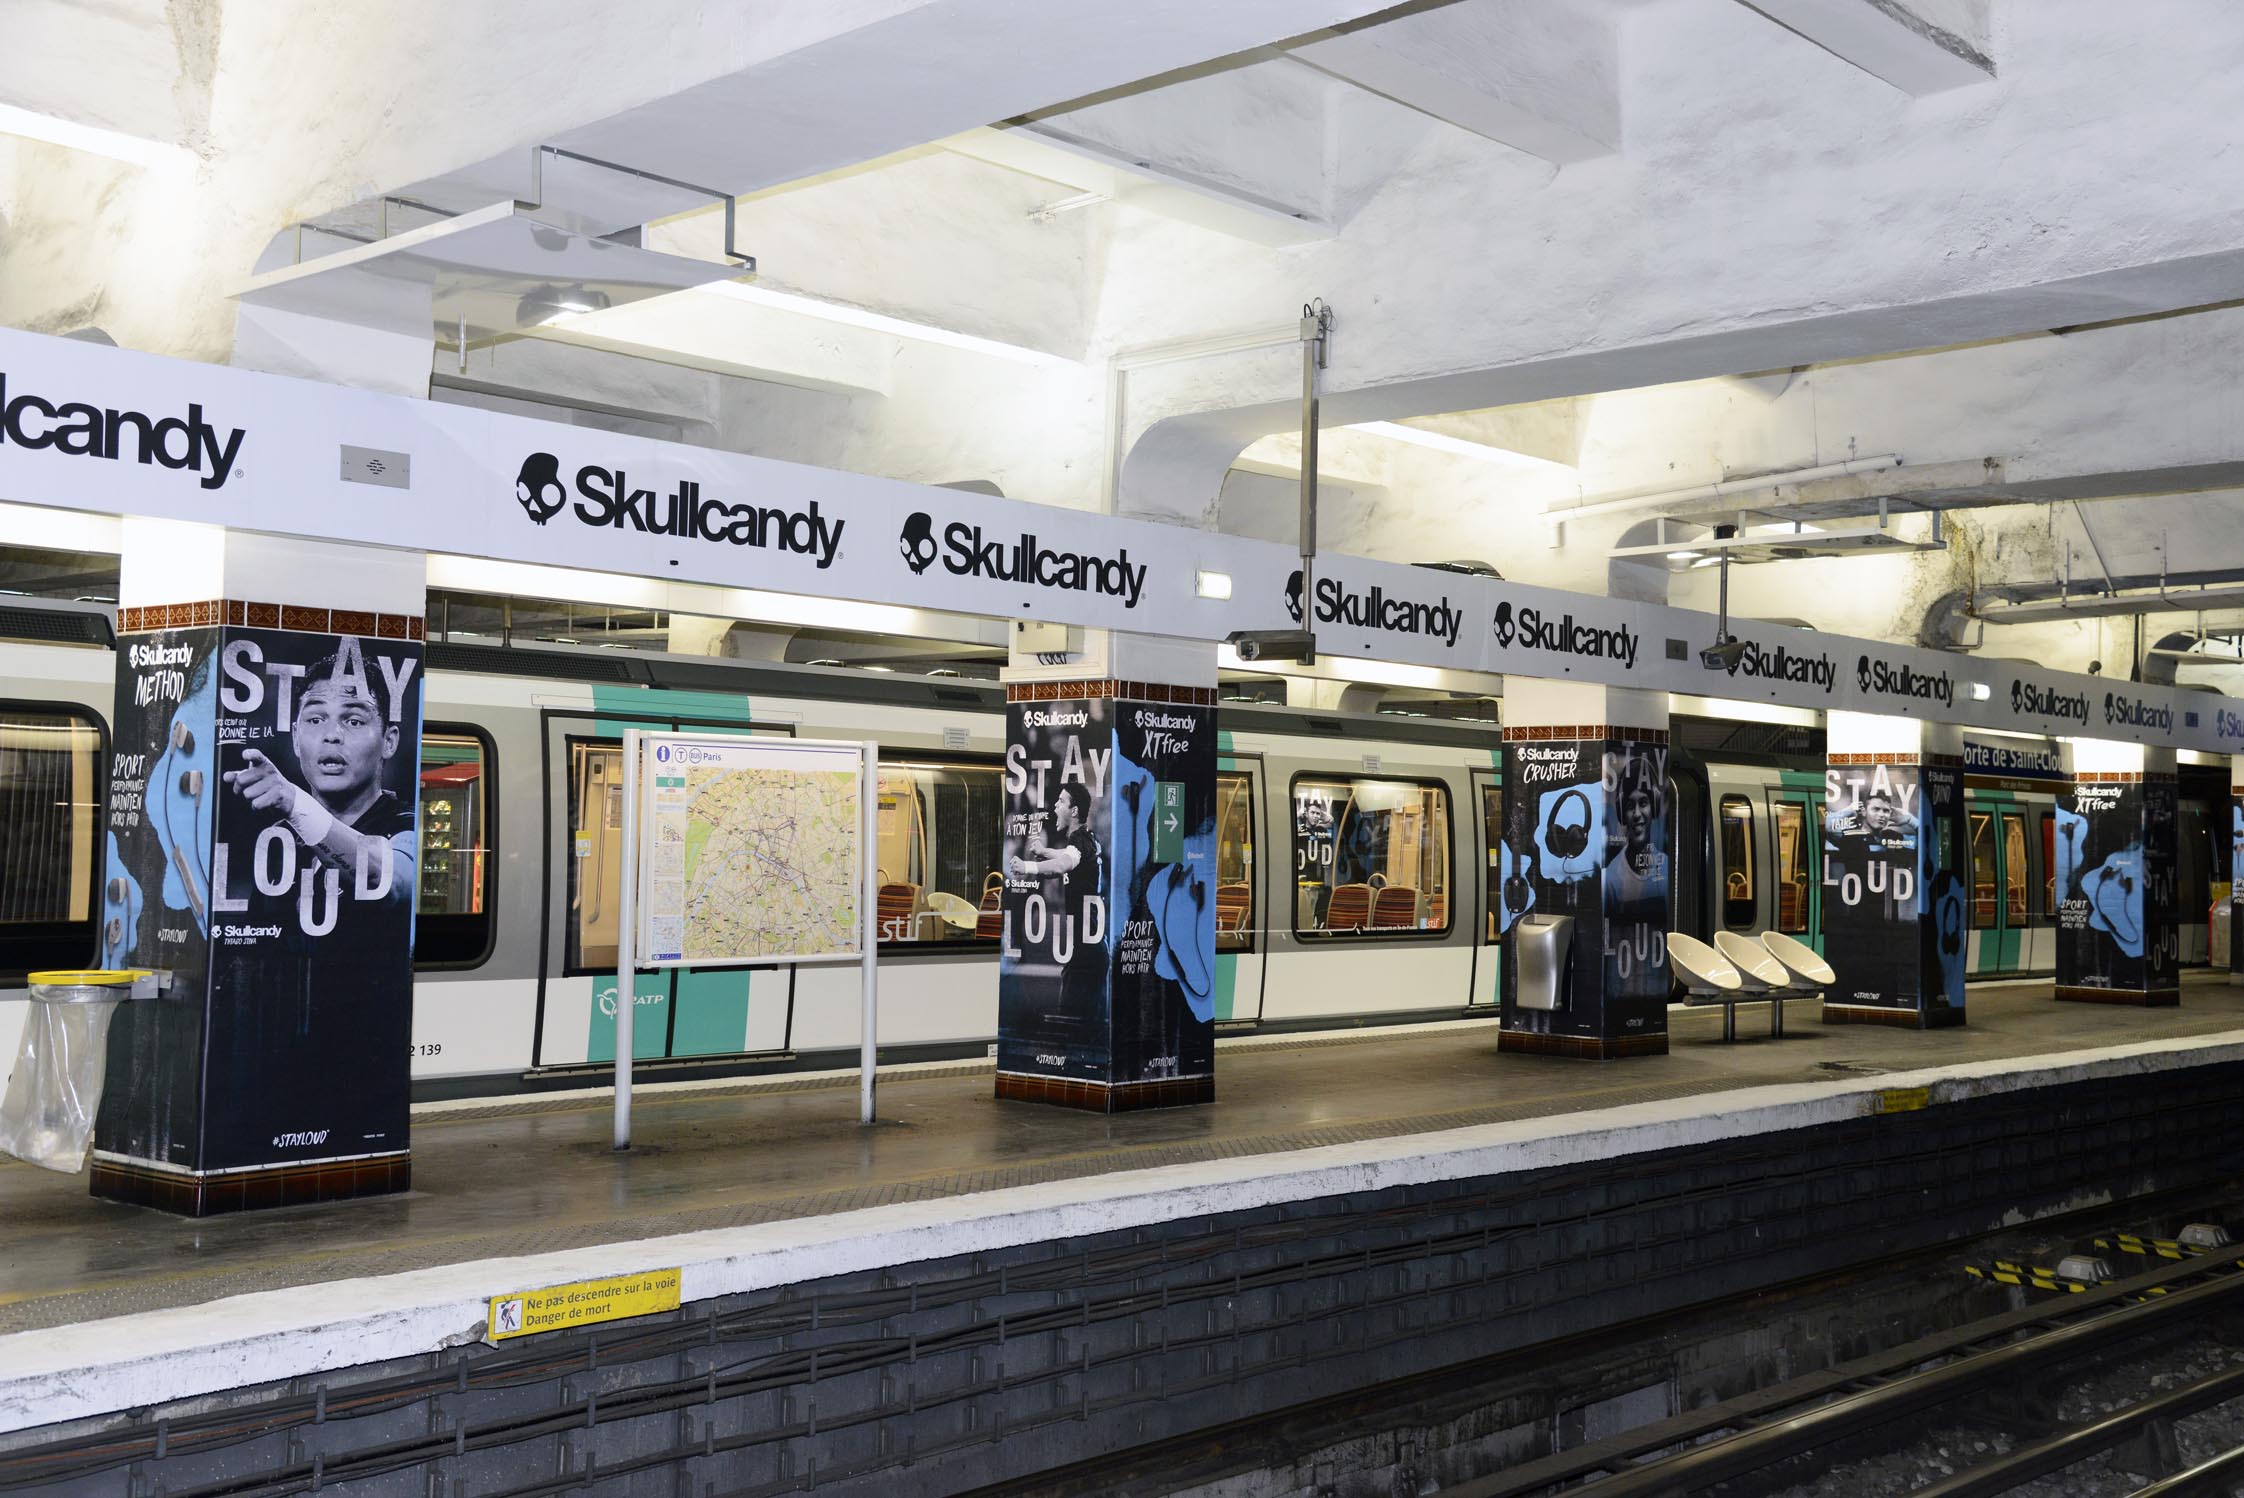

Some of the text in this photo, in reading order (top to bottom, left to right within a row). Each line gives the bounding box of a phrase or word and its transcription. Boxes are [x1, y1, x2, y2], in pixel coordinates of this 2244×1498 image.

[573, 465, 845, 569] Skullcandy
[942, 522, 1147, 609] Skullcandy
[1315, 577, 1462, 647] Skullcandy
[139, 642, 193, 668] Skullcandy
[1518, 608, 1638, 669] Skullcandy
[220, 636, 417, 732] STAY
[1742, 641, 1836, 693] Skullcandy
[1873, 660, 1954, 708] Skullcandy
[135, 670, 185, 707] METHOD
[2024, 683, 2090, 726] Skullcandy
[219, 727, 247, 738] DONNE
[248, 726, 260, 738] LE
[1033, 710, 1088, 728] Skullcandy
[1144, 711, 1196, 733] Skullcandy
[2116, 697, 2174, 735] Skullcandy
[112, 753, 145, 779] SPORT
[703, 752, 722, 761] Paris
[1005, 735, 1112, 809] STAY
[1526, 747, 1579, 762] Skullcandy
[1602, 741, 1668, 793] STAY
[1962, 744, 1989, 766] orte
[1993, 746, 2007, 767] de
[1523, 762, 1577, 784] CRUSHER
[1825, 764, 1917, 812] STAY
[2077, 787, 2122, 798] Skullcandy
[212, 825, 394, 937] LOUD
[1010, 879, 1040, 890] Skullcandy
[1823, 854, 1914, 906] LOUD
[2061, 899, 2087, 910] SPORT
[224, 924, 282, 938] Skullcandy
[1004, 894, 1106, 964] LOUD
[1121, 920, 1154, 939] SPORT
[1604, 917, 1665, 979] LOUD
[420, 1044, 442, 1056] 139
[527, 1277, 676, 1310] Ne pas descendre sur la voie
[526, 1302, 611, 1326] Danger de mort
